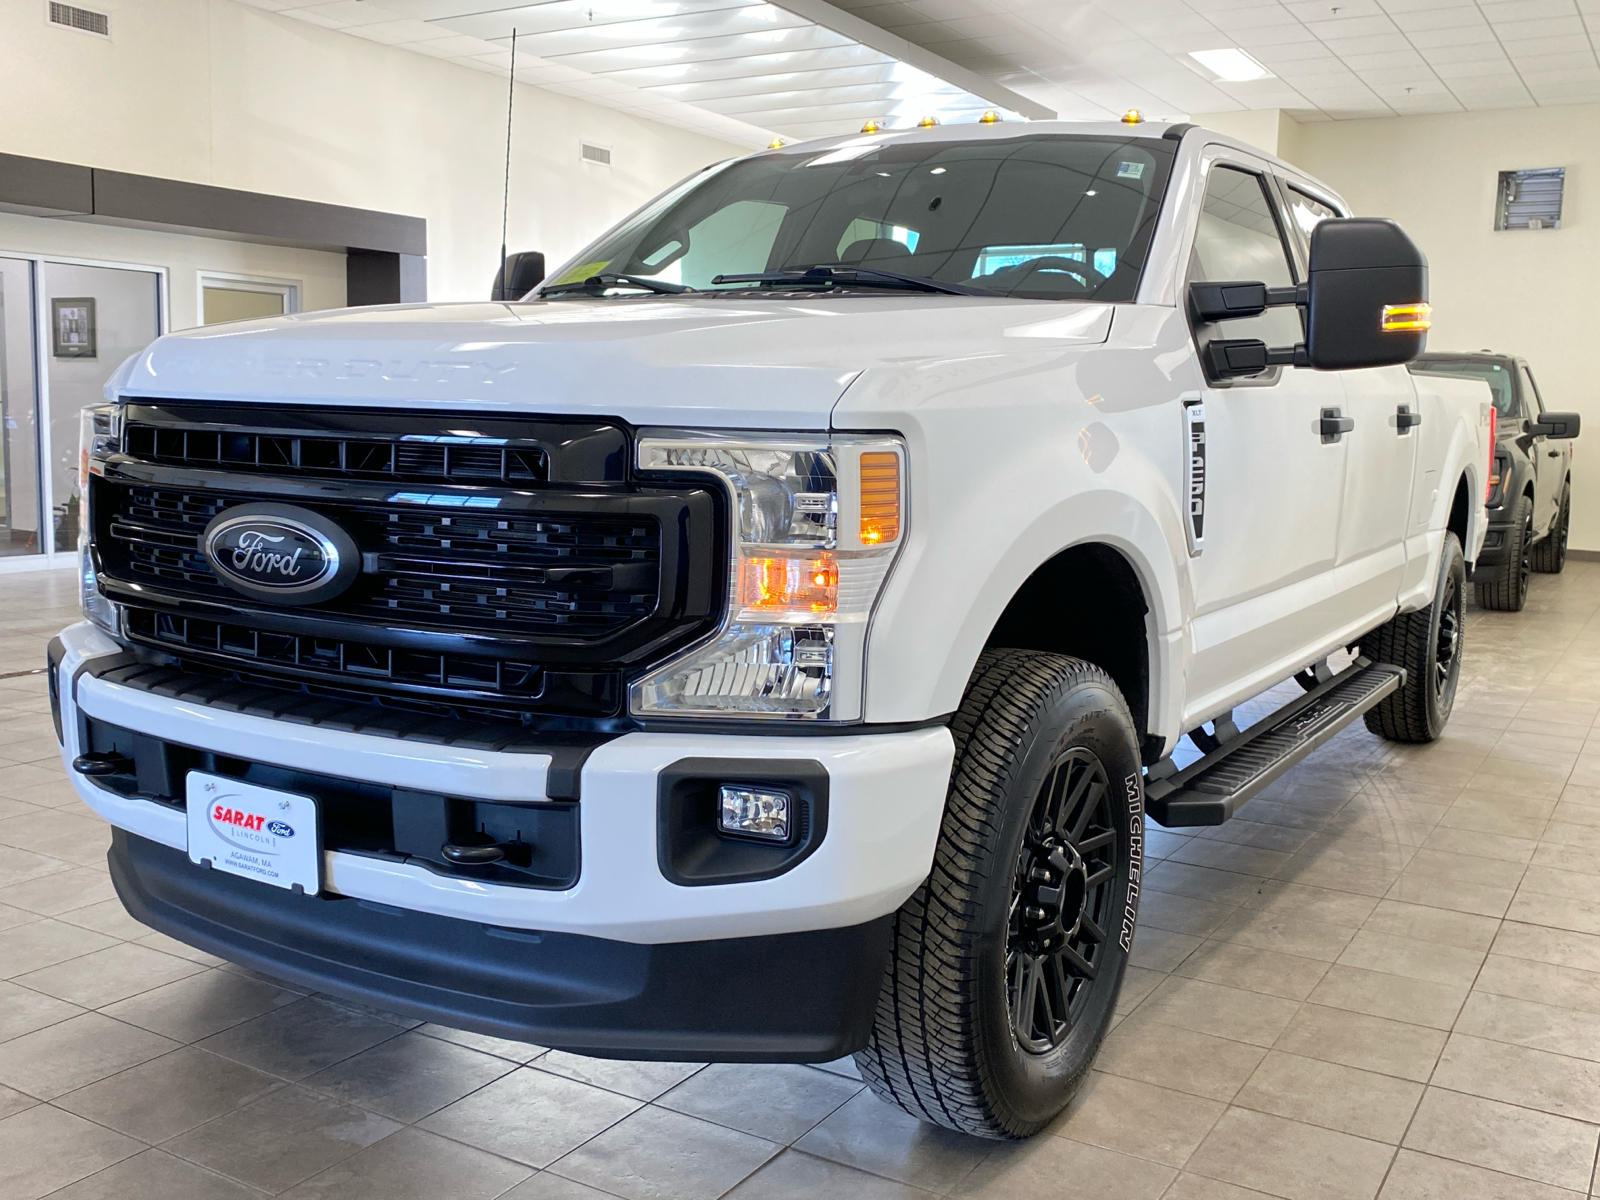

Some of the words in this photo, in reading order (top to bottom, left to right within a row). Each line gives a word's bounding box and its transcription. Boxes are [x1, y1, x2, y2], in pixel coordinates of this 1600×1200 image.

[336, 359, 519, 381] DUTY
[232, 530, 303, 577] Ford
[213, 804, 265, 832] SARAT
[271, 822, 291, 837] Ford
[236, 830, 270, 844] LINCOLN
[224, 858, 280, 878] WWW.SARATFORD.COM
[230, 851, 260, 866] AGAWAM,
[261, 859, 272, 868] MA
[1119, 772, 1142, 953] MICHELIN
